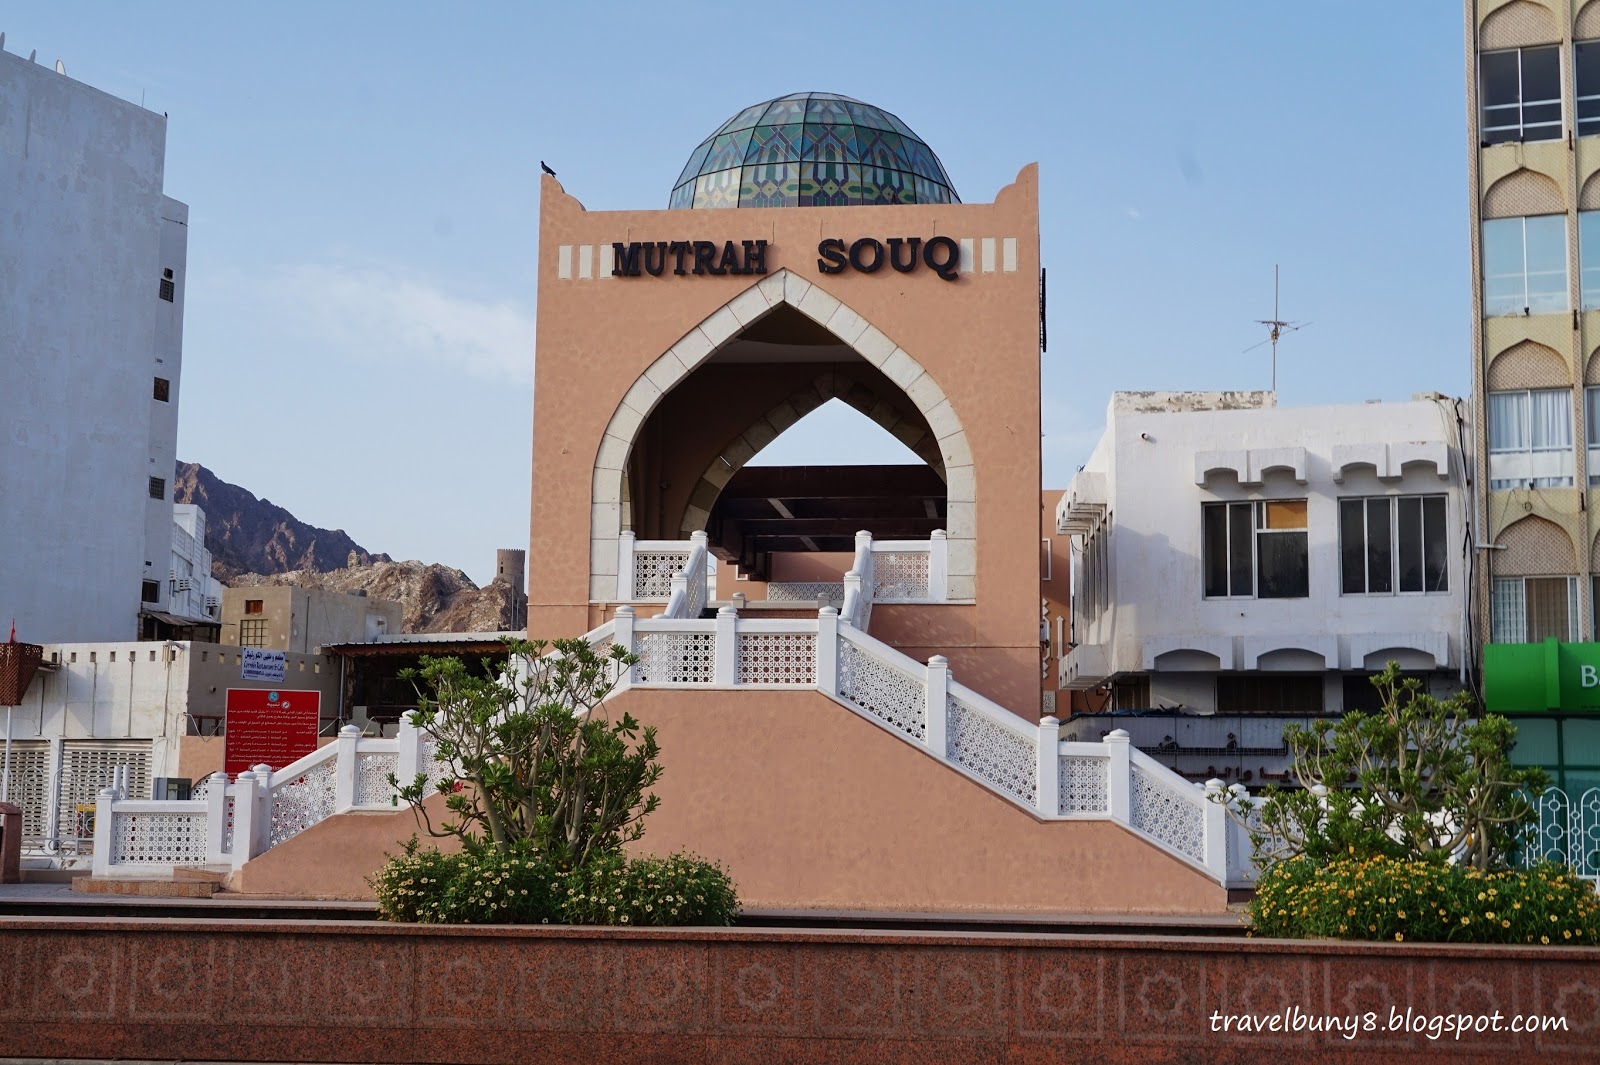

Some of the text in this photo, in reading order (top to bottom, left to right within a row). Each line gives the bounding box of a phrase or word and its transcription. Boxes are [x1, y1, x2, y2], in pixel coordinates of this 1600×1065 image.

[611, 237, 960, 281] MUTRAH SOUQ
[1580, 664, 1600, 688] B
